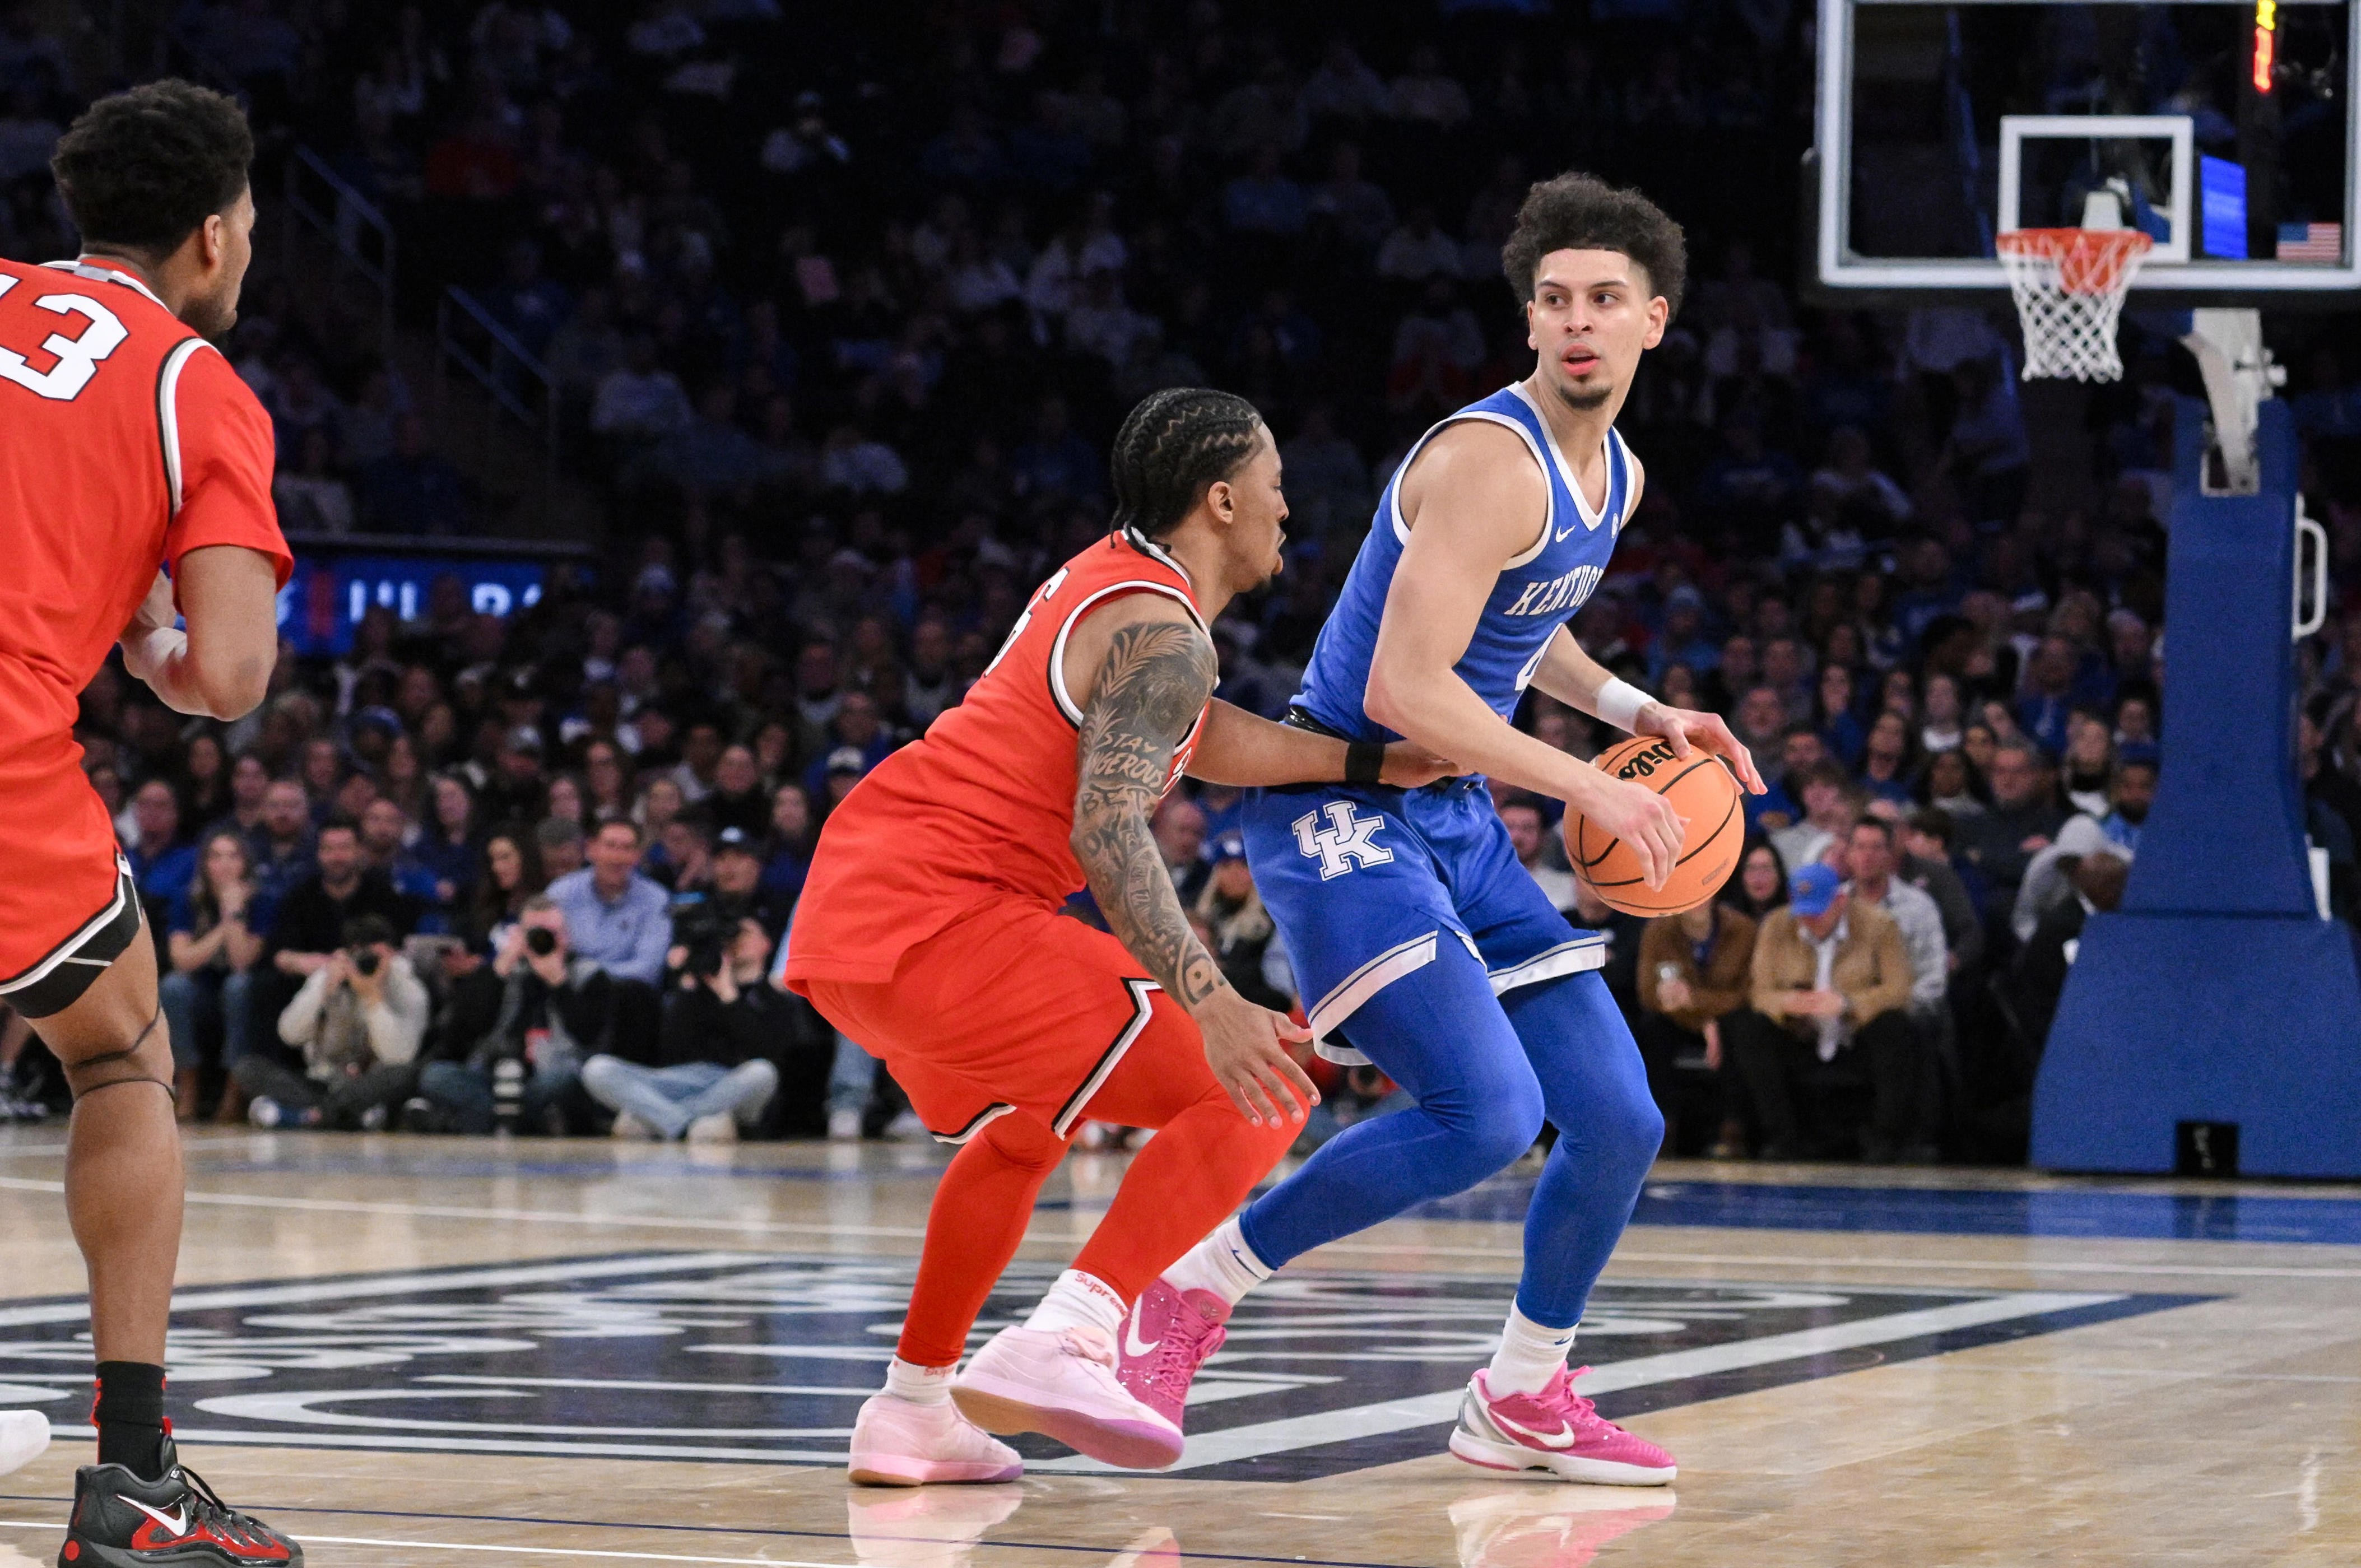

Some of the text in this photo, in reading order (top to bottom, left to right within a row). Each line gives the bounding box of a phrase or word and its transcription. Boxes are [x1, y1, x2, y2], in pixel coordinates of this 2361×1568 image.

[0, 273, 131, 402] 3
[1504, 565, 1605, 616] KENTUC
[1087, 751, 1166, 788] NGEROUS
[1616, 741, 1677, 780] Wils
[1292, 800, 1395, 881] UK
